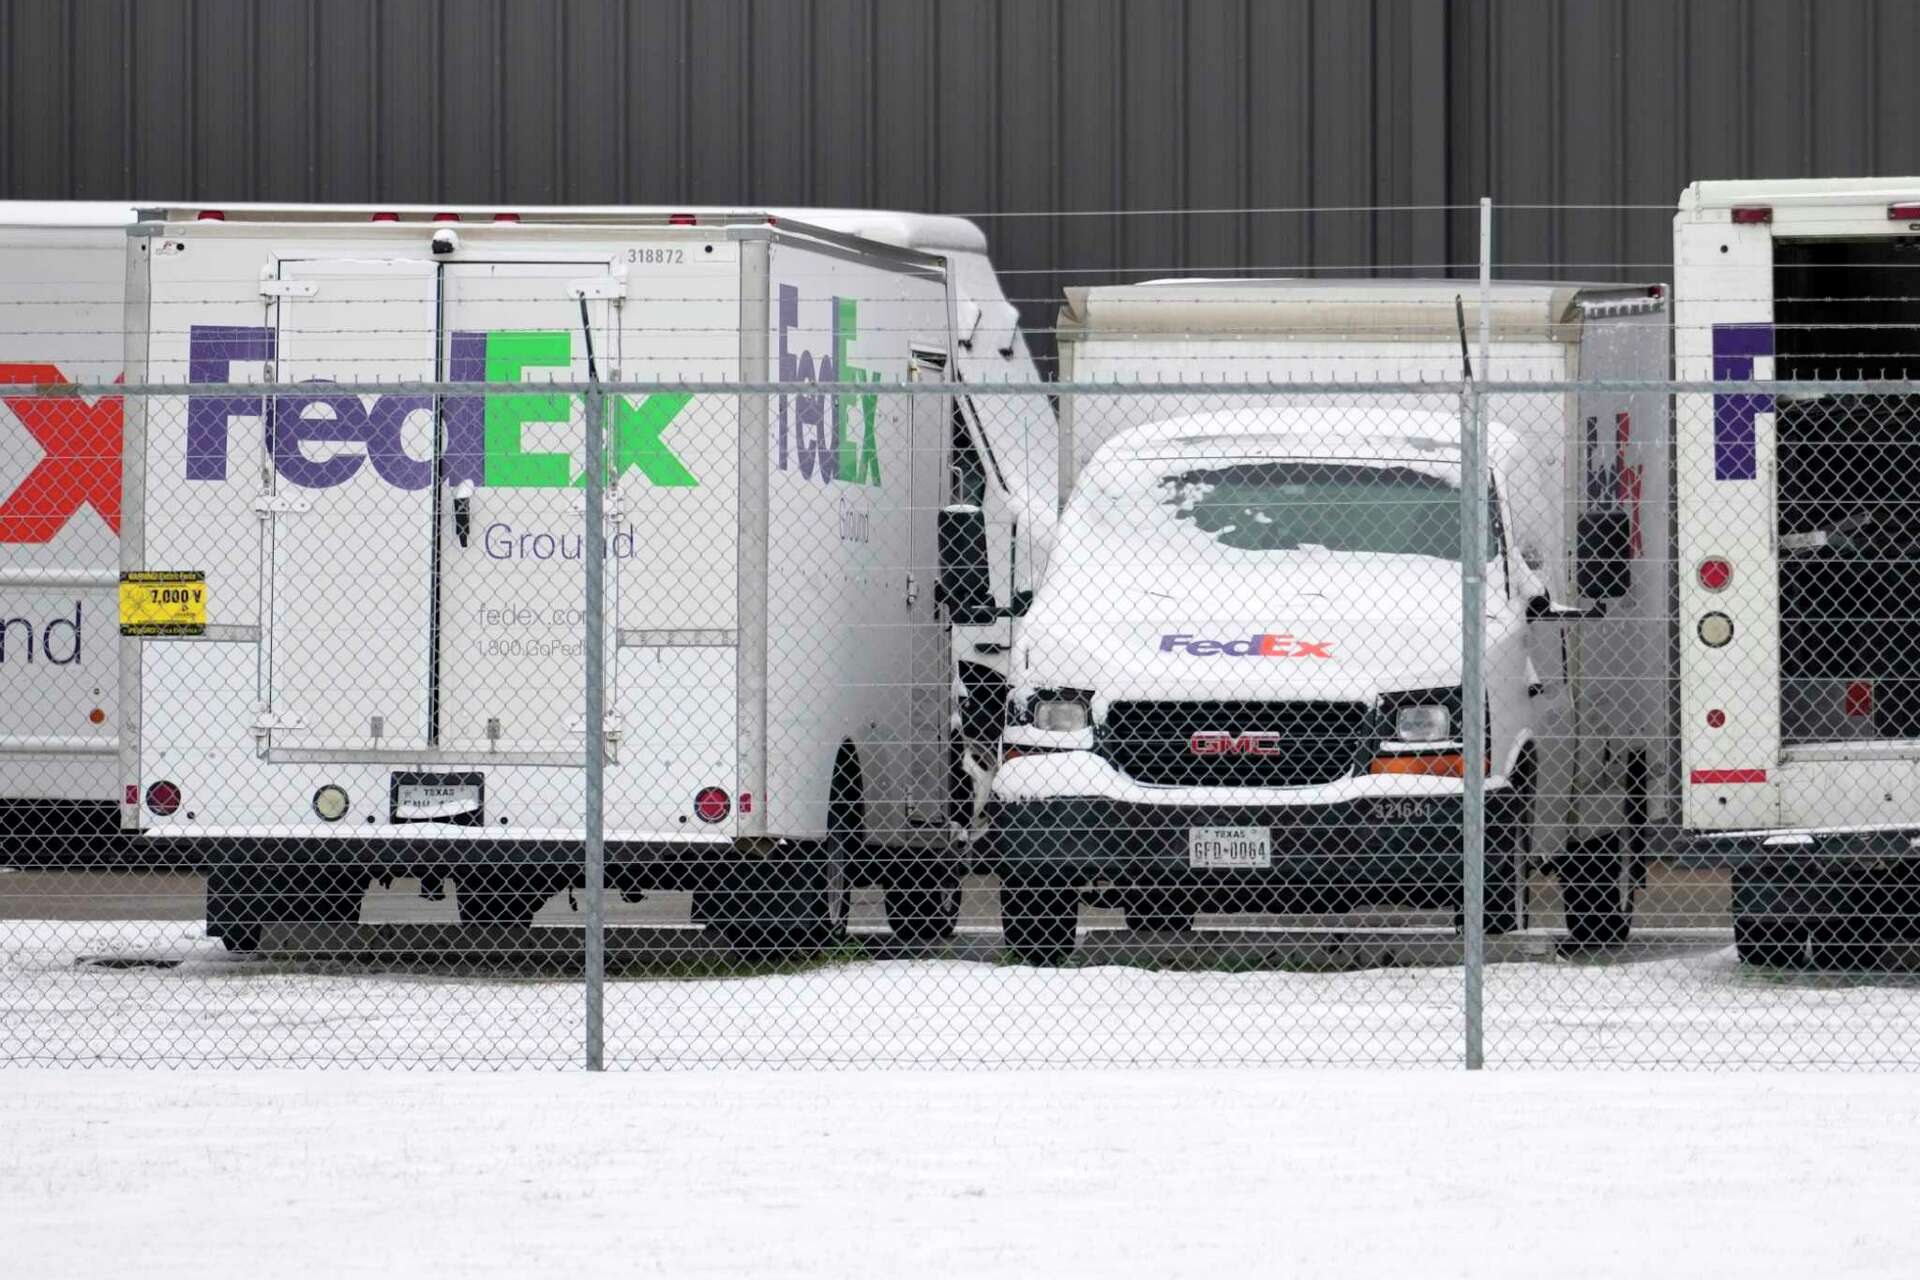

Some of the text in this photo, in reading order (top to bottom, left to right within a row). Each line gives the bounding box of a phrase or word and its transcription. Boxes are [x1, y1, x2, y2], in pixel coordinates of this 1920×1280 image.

[627, 248, 684, 264] 318872
[779, 283, 881, 488] FedEx
[186, 325, 699, 490] FedEx
[151, 589, 202, 604] 7,000 V
[478, 603, 586, 626] fedex.co
[1160, 634, 1336, 658] FedEx
[1189, 731, 1281, 756] GMC
[423, 788, 456, 797] TEXAS
[1214, 830, 1246, 838] TEXAS
